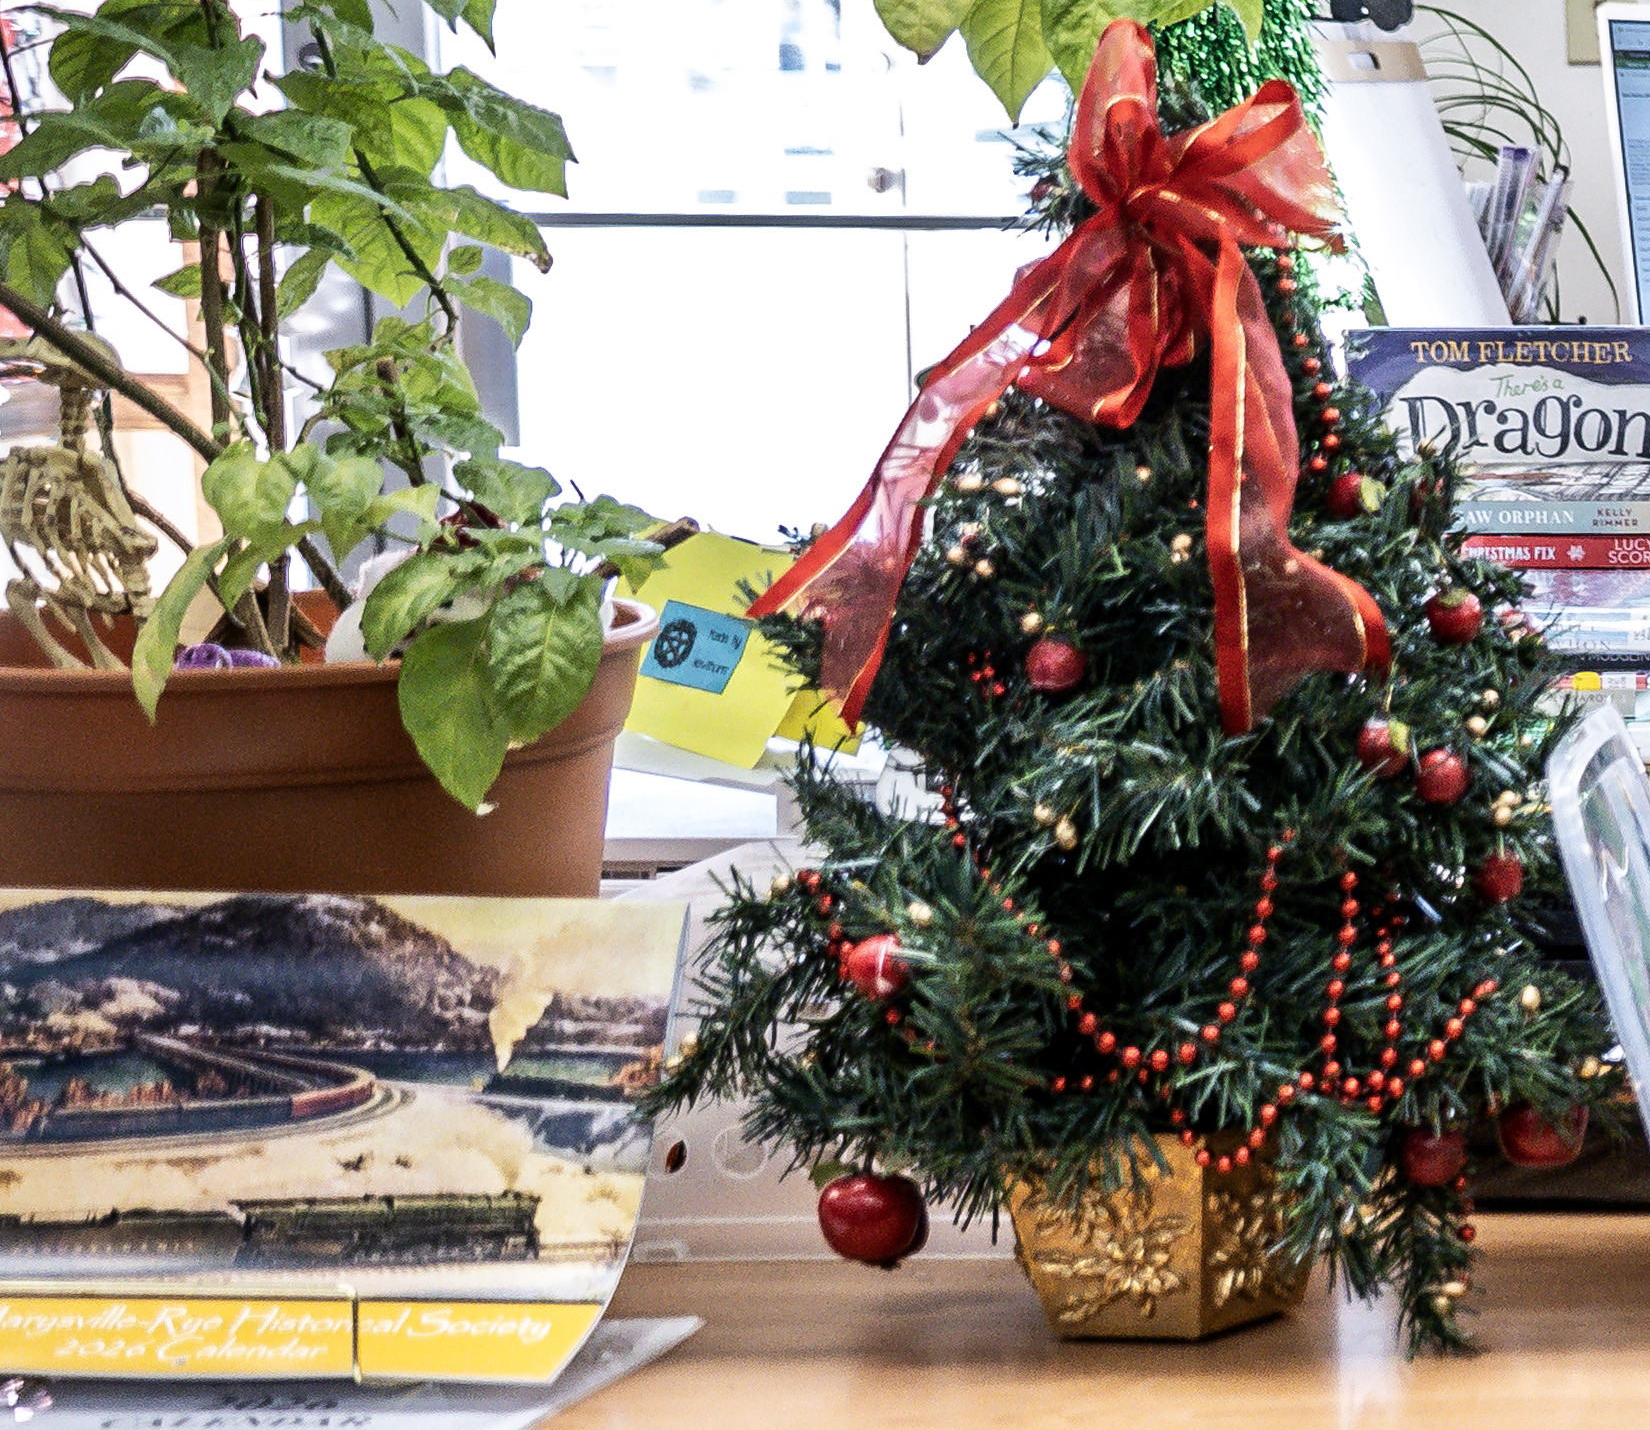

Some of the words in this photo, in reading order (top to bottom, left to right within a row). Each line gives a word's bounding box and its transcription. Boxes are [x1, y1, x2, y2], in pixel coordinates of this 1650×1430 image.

[1411, 341, 1470, 364] TOM
[1478, 340, 1633, 365] FLETCHER
[1490, 373, 1548, 401] There's
[1551, 377, 1566, 391] a
[1498, 509, 1576, 526] ORPHAN
[1592, 517, 1639, 528] RIMMER
[1597, 507, 1633, 518] KELLY
[1533, 546, 1557, 562] FIX
[0, 1304, 224, 1337] arysville-Rye
[407, 1308, 553, 1343] Society
[53, 1337, 147, 1358] 2026
[157, 1336, 330, 1362] Calendar
